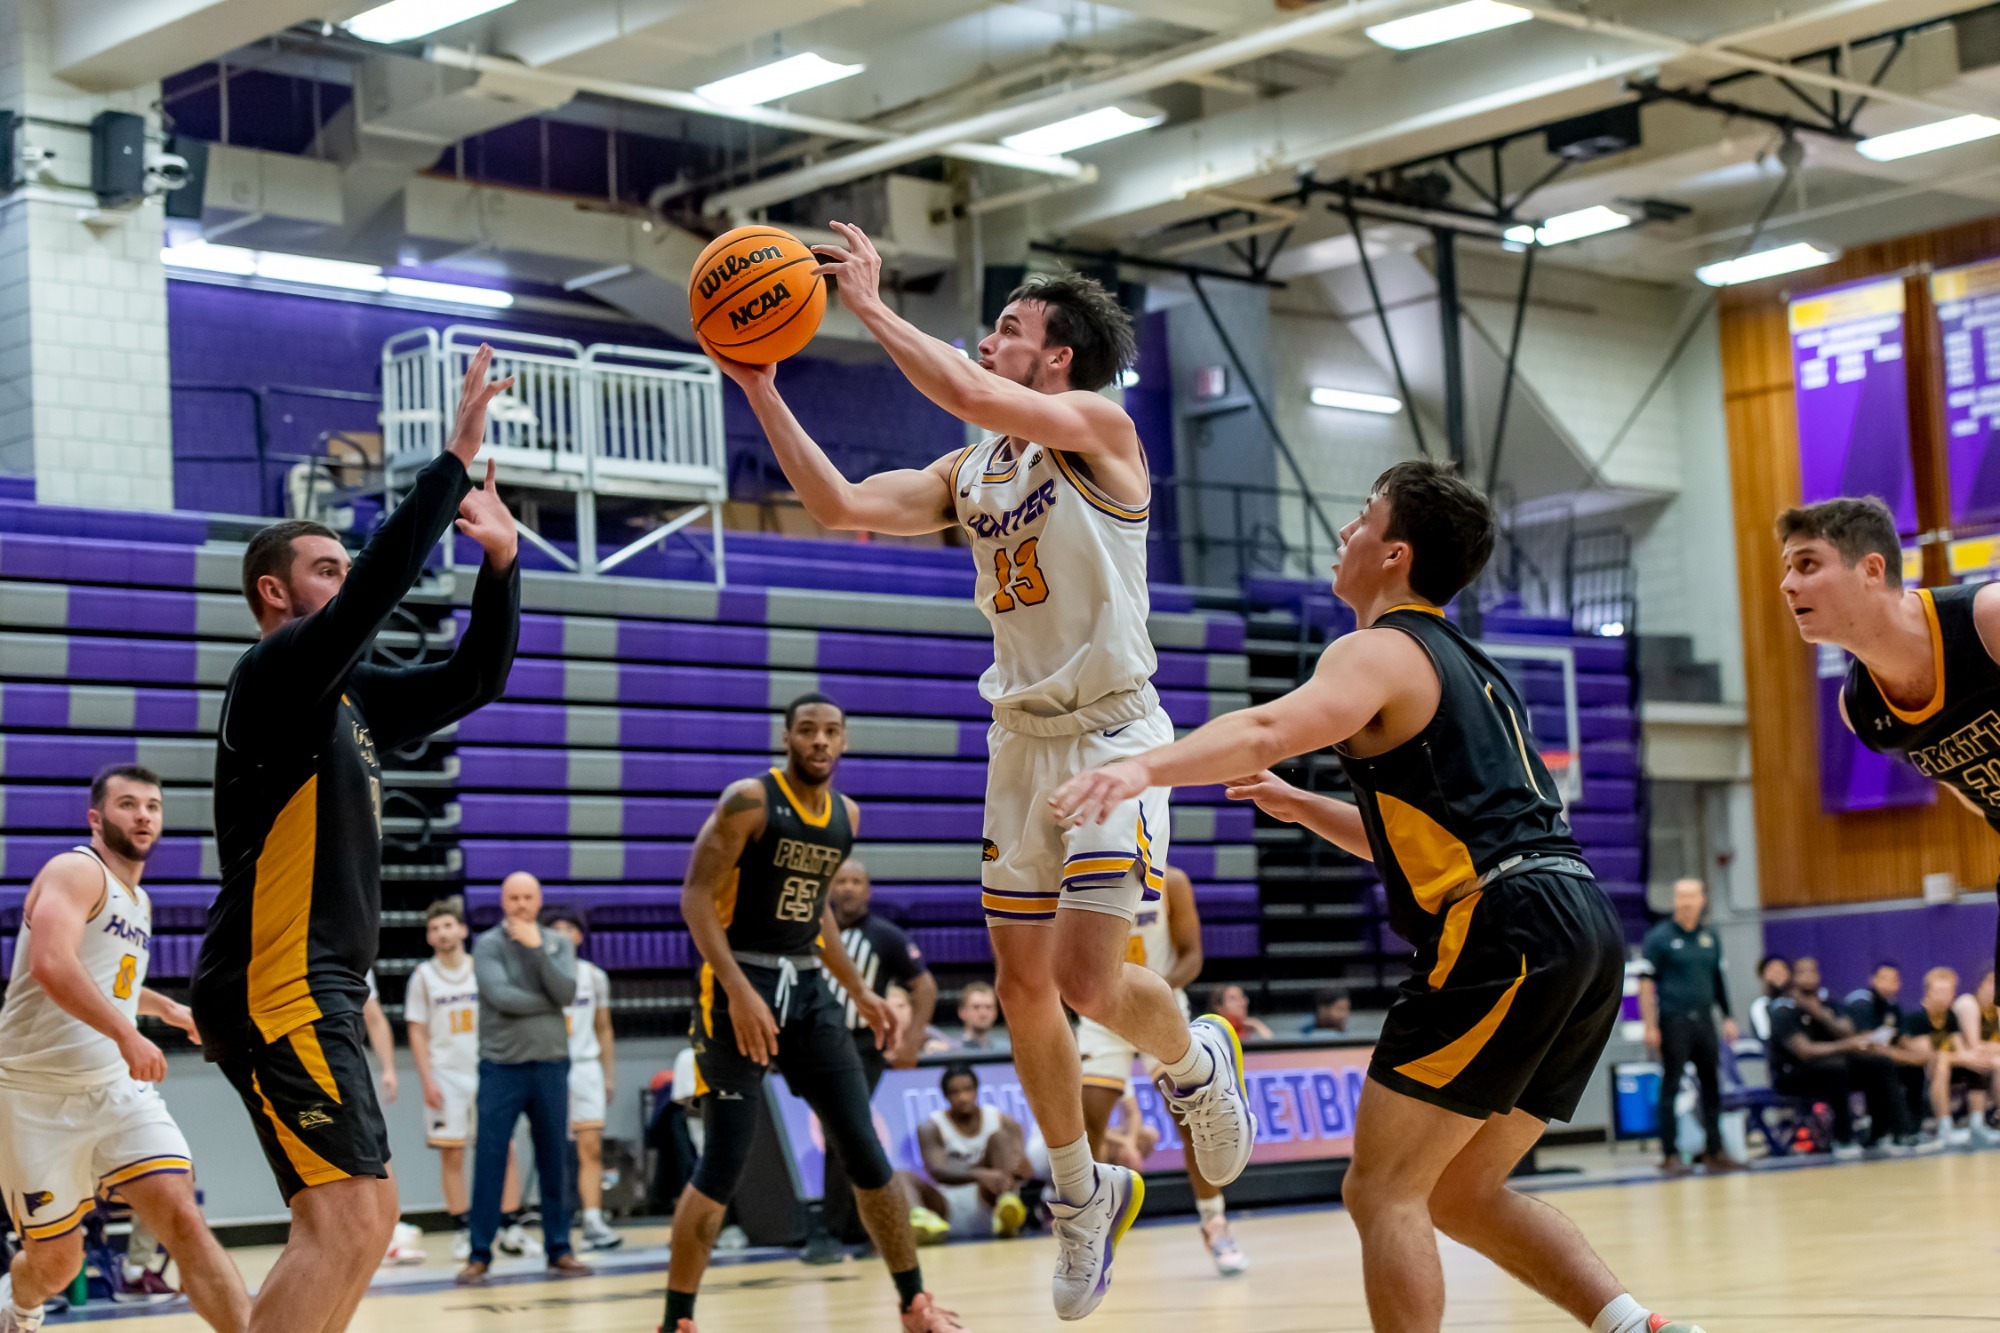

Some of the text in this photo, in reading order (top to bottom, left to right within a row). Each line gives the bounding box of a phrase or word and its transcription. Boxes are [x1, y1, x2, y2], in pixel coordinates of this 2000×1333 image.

[697, 245, 784, 300] Wilson
[728, 282, 792, 331] NCAA
[992, 536, 1050, 615] 13
[773, 837, 842, 877] PRATT
[103, 914, 152, 951] HUNTE
